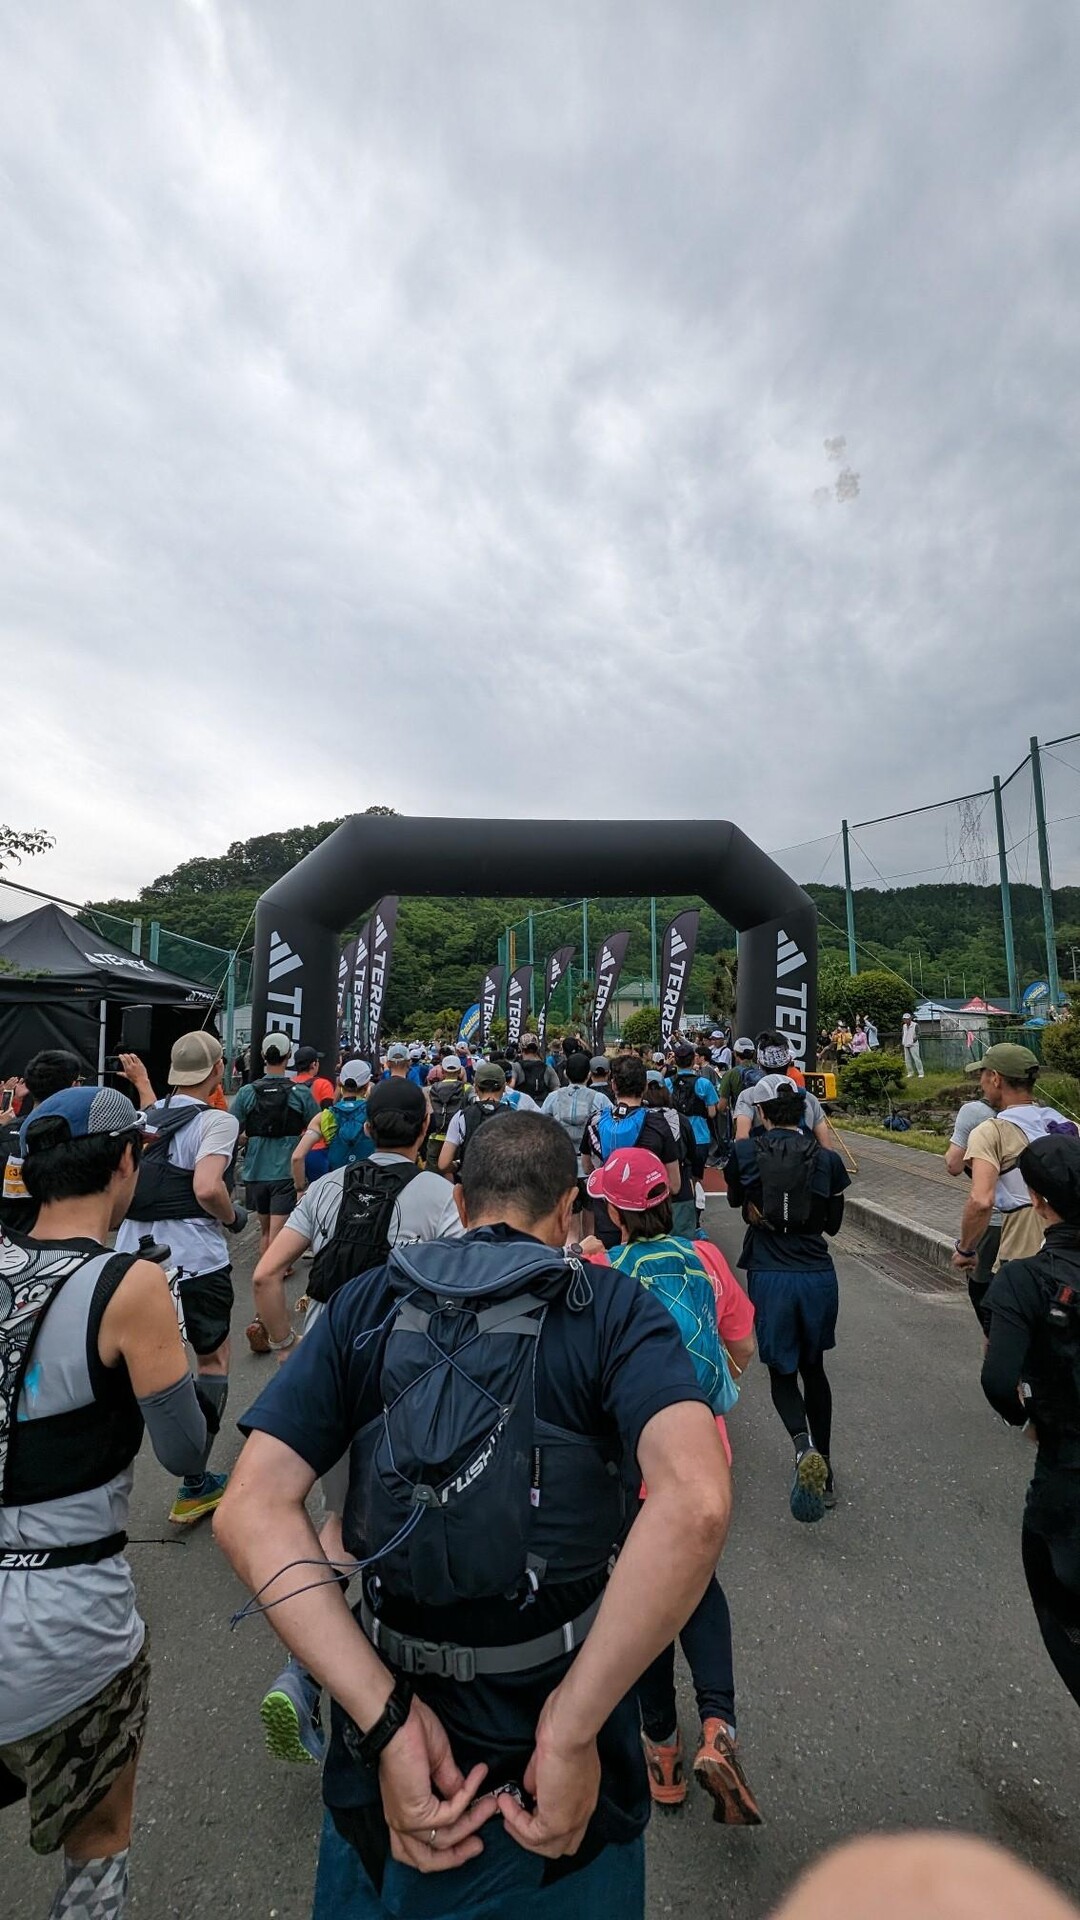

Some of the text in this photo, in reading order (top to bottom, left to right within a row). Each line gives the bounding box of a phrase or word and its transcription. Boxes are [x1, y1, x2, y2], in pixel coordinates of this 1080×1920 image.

[369, 951, 387, 1053] TERREX
[660, 960, 687, 1050] TERREX
[775, 982, 808, 1073] TER
[0, 1552, 51, 1568] 2XU
